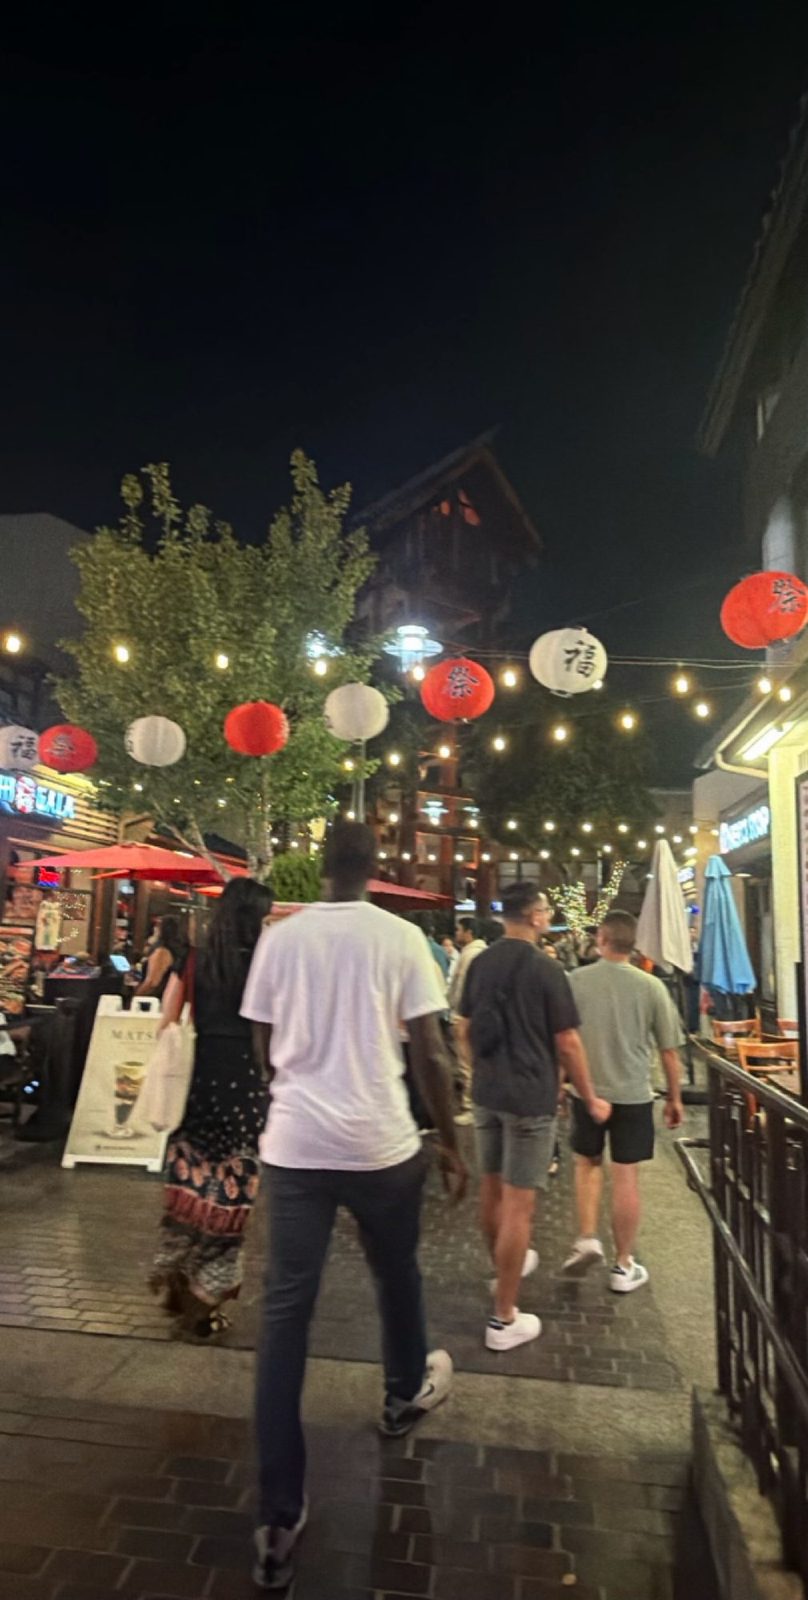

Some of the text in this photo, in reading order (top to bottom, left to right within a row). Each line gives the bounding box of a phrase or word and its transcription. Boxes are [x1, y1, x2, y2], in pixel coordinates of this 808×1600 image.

[772, 578, 805, 614] 祭
[564, 640, 597, 678] 福
[446, 666, 478, 698] 祭
